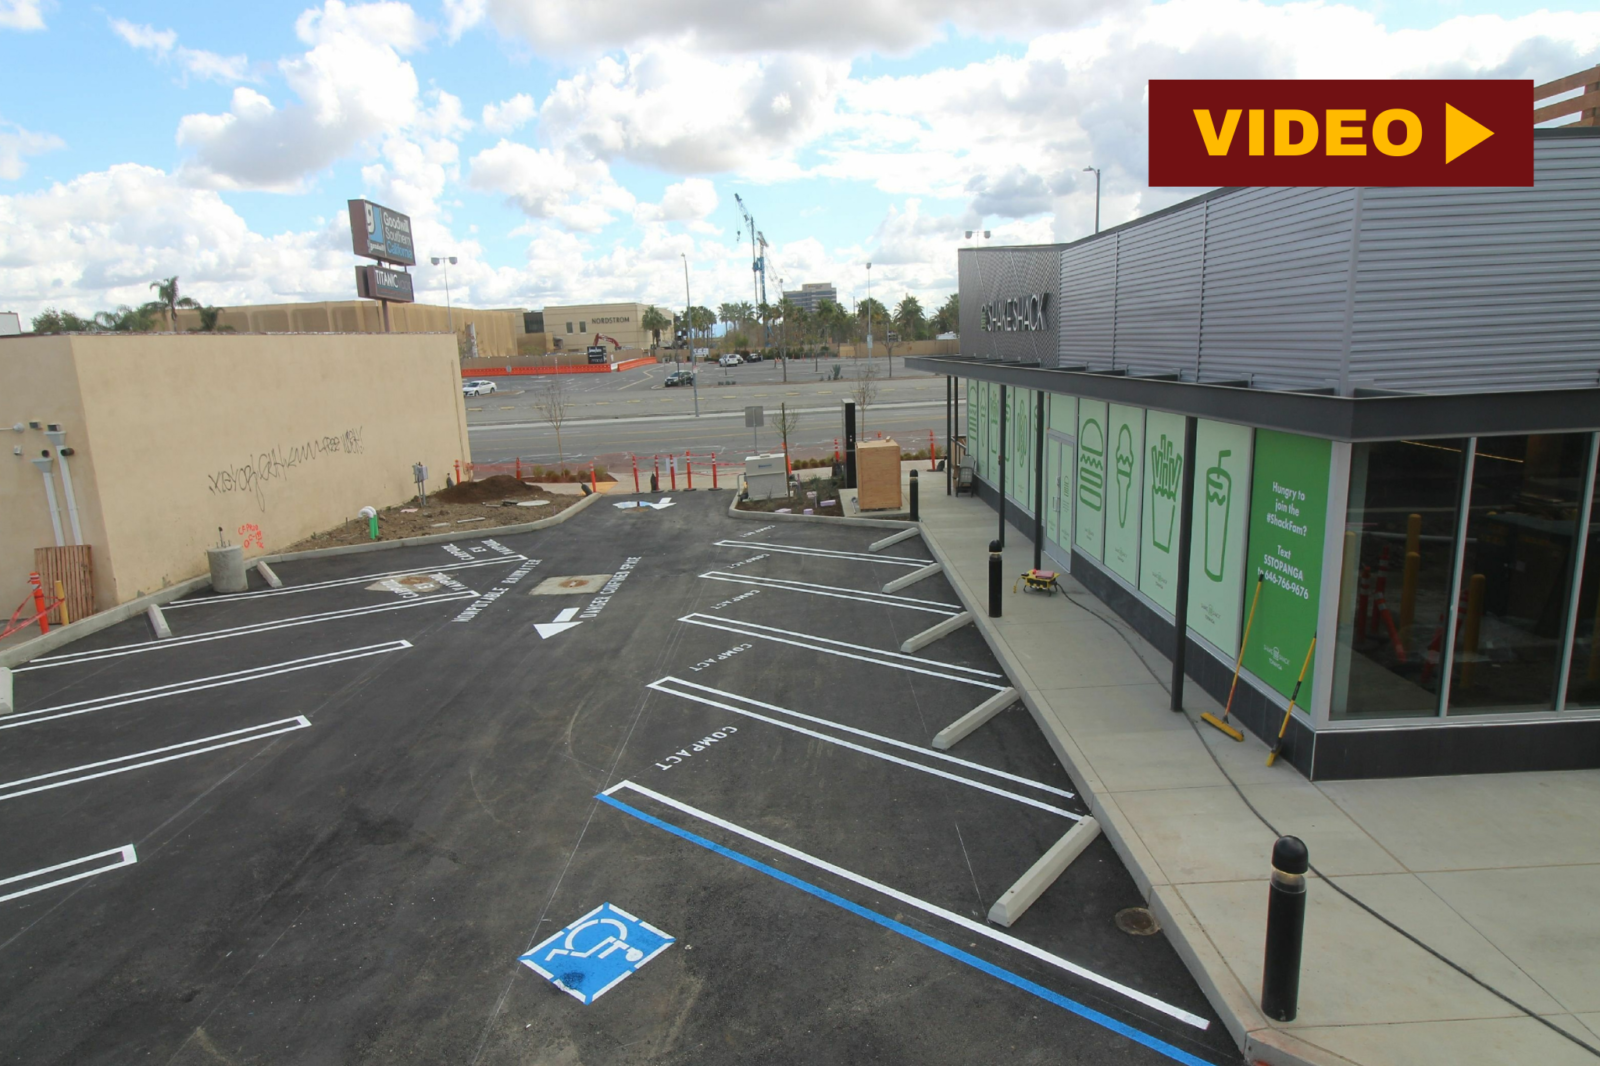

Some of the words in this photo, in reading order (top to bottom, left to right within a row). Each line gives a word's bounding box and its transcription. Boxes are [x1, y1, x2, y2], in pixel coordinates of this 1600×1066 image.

[383, 212, 410, 232] Goodwill
[385, 228, 411, 245] Southern
[386, 241, 412, 258] California
[375, 270, 398, 288] TITANIC
[592, 316, 630, 324] NORDSTROM
[1272, 481, 1297, 501] Hungry
[1298, 490, 1305, 501] to
[1275, 498, 1287, 512] join
[1288, 503, 1299, 517] the
[1266, 512, 1307, 537] #ShackFam?
[1277, 544, 1291, 560] Text
[1264, 569, 1309, 600] 646-766-9676
[710, 589, 761, 610] COMPACT
[689, 643, 753, 672] COMPACT
[655, 726, 738, 771] COMPACT
